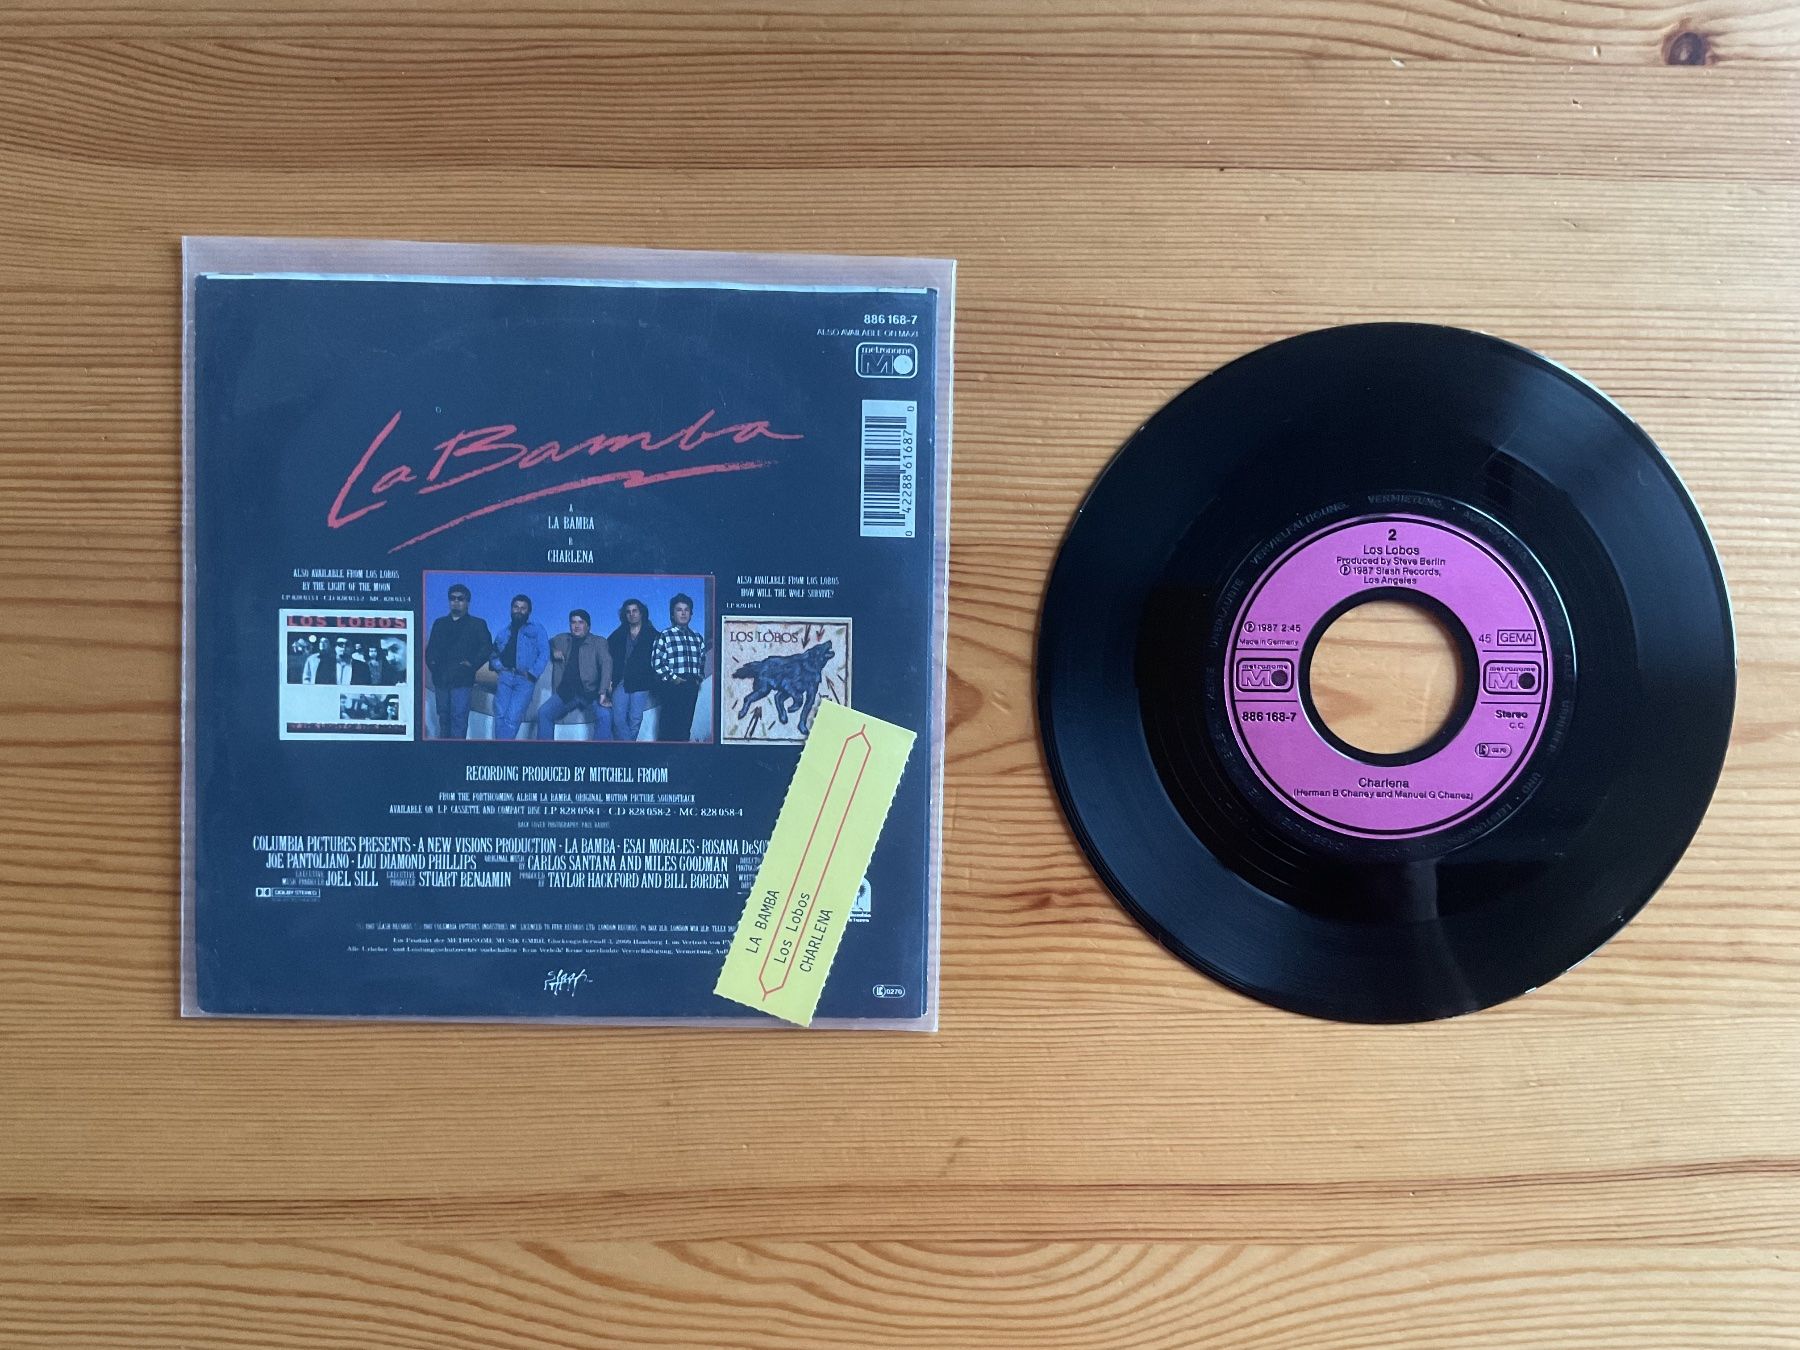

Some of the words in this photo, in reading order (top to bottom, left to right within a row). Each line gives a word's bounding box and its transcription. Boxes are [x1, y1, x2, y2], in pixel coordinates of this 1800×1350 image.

[864, 314, 885, 325] 886
[888, 314, 918, 325] 168-7
[328, 410, 417, 528] La
[417, 409, 804, 495] Bamba
[548, 516, 560, 529] LA
[563, 516, 594, 530] BAMBA
[1387, 528, 1397, 541] 2
[547, 549, 594, 563] CHARLENA
[1363, 545, 1383, 555] Los
[1385, 545, 1420, 556] Lobos
[1336, 556, 1379, 566] Produced
[1380, 557, 1391, 567] by
[1393, 557, 1418, 566] Steve
[1419, 557, 1446, 566] Berlin
[293, 568, 308, 578] ALSO
[311, 569, 344, 578] AVAILABLE
[346, 569, 363, 579] FROM
[365, 570, 378, 579] LOS
[380, 570, 400, 579] LOBOS
[1353, 566, 1374, 575] 1987
[1376, 567, 1400, 576] Slash
[1402, 568, 1441, 577] Records,
[737, 575, 752, 585] ALSO
[754, 576, 785, 585] AVAILABLE
[788, 576, 804, 585] FROM
[806, 576, 818, 585] LOS
[820, 576, 840, 586] LOBOS
[1363, 576, 1380, 584] Los
[1381, 577, 1417, 586] Angeles
[302, 582, 310, 591] BY
[313, 582, 325, 591] THE
[327, 582, 346, 591] LIGHT
[348, 582, 356, 591] OF
[359, 582, 371, 592] THE
[373, 583, 391, 592] MOON
[741, 588, 755, 597] HOW
[757, 588, 772, 597] WILL
[775, 589, 787, 598] THE
[789, 589, 804, 598] WOLF
[287, 616, 328, 628] LOS
[336, 617, 407, 630] LOBOS
[1258, 624, 1278, 632] 1987
[1281, 624, 1301, 632] 2:45
[730, 632, 754, 642] LOS
[1478, 633, 1492, 643] 45
[1500, 632, 1533, 643] GEMA
[1267, 639, 1299, 647] Germany
[1242, 711, 1264, 722] 886
[1265, 711, 1297, 722] 168-7
[1495, 709, 1528, 719] Stereo
[466, 765, 519, 781] RECORDING
[522, 766, 571, 782] PRODUCED
[574, 767, 586, 782] BY
[589, 767, 634, 783] MITCHELL
[637, 768, 669, 783] FROOM
[1358, 777, 1409, 788] Charlena
[439, 791, 456, 801] FROM
[457, 792, 471, 801] THE
[473, 792, 514, 801] FORTHCOMING
[516, 793, 538, 802] ALBUM
[540, 793, 548, 802] LA
[576, 793, 603, 802] ORIGINAL
[606, 794, 628, 802] MOTION
[630, 794, 656, 803] PICTURE
[658, 794, 696, 803] SOUNDTRACK
[1293, 788, 1331, 797] (Herman
[1332, 789, 1339, 797] B
[1341, 789, 1375, 799] Chaney
[1376, 790, 1392, 798] and
[1394, 791, 1427, 799] Manuel
[1428, 791, 1436, 799] G
[389, 804, 424, 814] AVAILABLE
[425, 805, 435, 814] ON
[450, 805, 480, 814] CASSETTE
[483, 805, 496, 815] AND
[498, 806, 525, 815] COMPACT
[560, 807, 576, 815] 828
[628, 807, 645, 816] 828
[647, 807, 672, 817] 058-2
[701, 807, 718, 817] 828
[719, 807, 743, 817] 058-4
[253, 836, 304, 851] COLUMBIA
[307, 836, 357, 852] PICTURES
[359, 837, 411, 852] PRESENTS
[417, 837, 425, 852] A
[427, 837, 452, 853] NEW
[455, 837, 493, 853] VISIONS
[496, 838, 556, 853] PRODUCTION
[565, 838, 578, 853] LA
[581, 838, 616, 854] BAMBA
[624, 838, 646, 854] ESAI
[649, 839, 695, 854] MORALES
[702, 839, 739, 854] ROSANA
[266, 853, 284, 868] JOE
[287, 853, 350, 868] PANTOLIANO
[358, 853, 377, 869] LOU
[380, 854, 426, 869] DIAMOND
[428, 854, 477, 870] PHILLIPS
[527, 855, 567, 871] CARLOS
[569, 855, 616, 871] SANTANA
[619, 856, 642, 871] AND
[645, 856, 677, 871] MILES
[679, 856, 728, 872] GOODMAN
[326, 870, 351, 886] JOEL
[355, 871, 379, 886] SILL
[418, 871, 458, 887] STUART
[460, 872, 512, 887] BENJAMIN
[548, 872, 585, 888] TAYLOR
[587, 872, 639, 888] HACKFORD
[641, 873, 662, 888] AND
[664, 873, 688, 889] BILL
[690, 873, 729, 889] BORDEN
[745, 936, 762, 954] LA
[755, 889, 780, 930] BAMBA
[774, 939, 793, 964] Los
[785, 892, 810, 932] Lobos
[799, 908, 833, 973] CHARLENA
